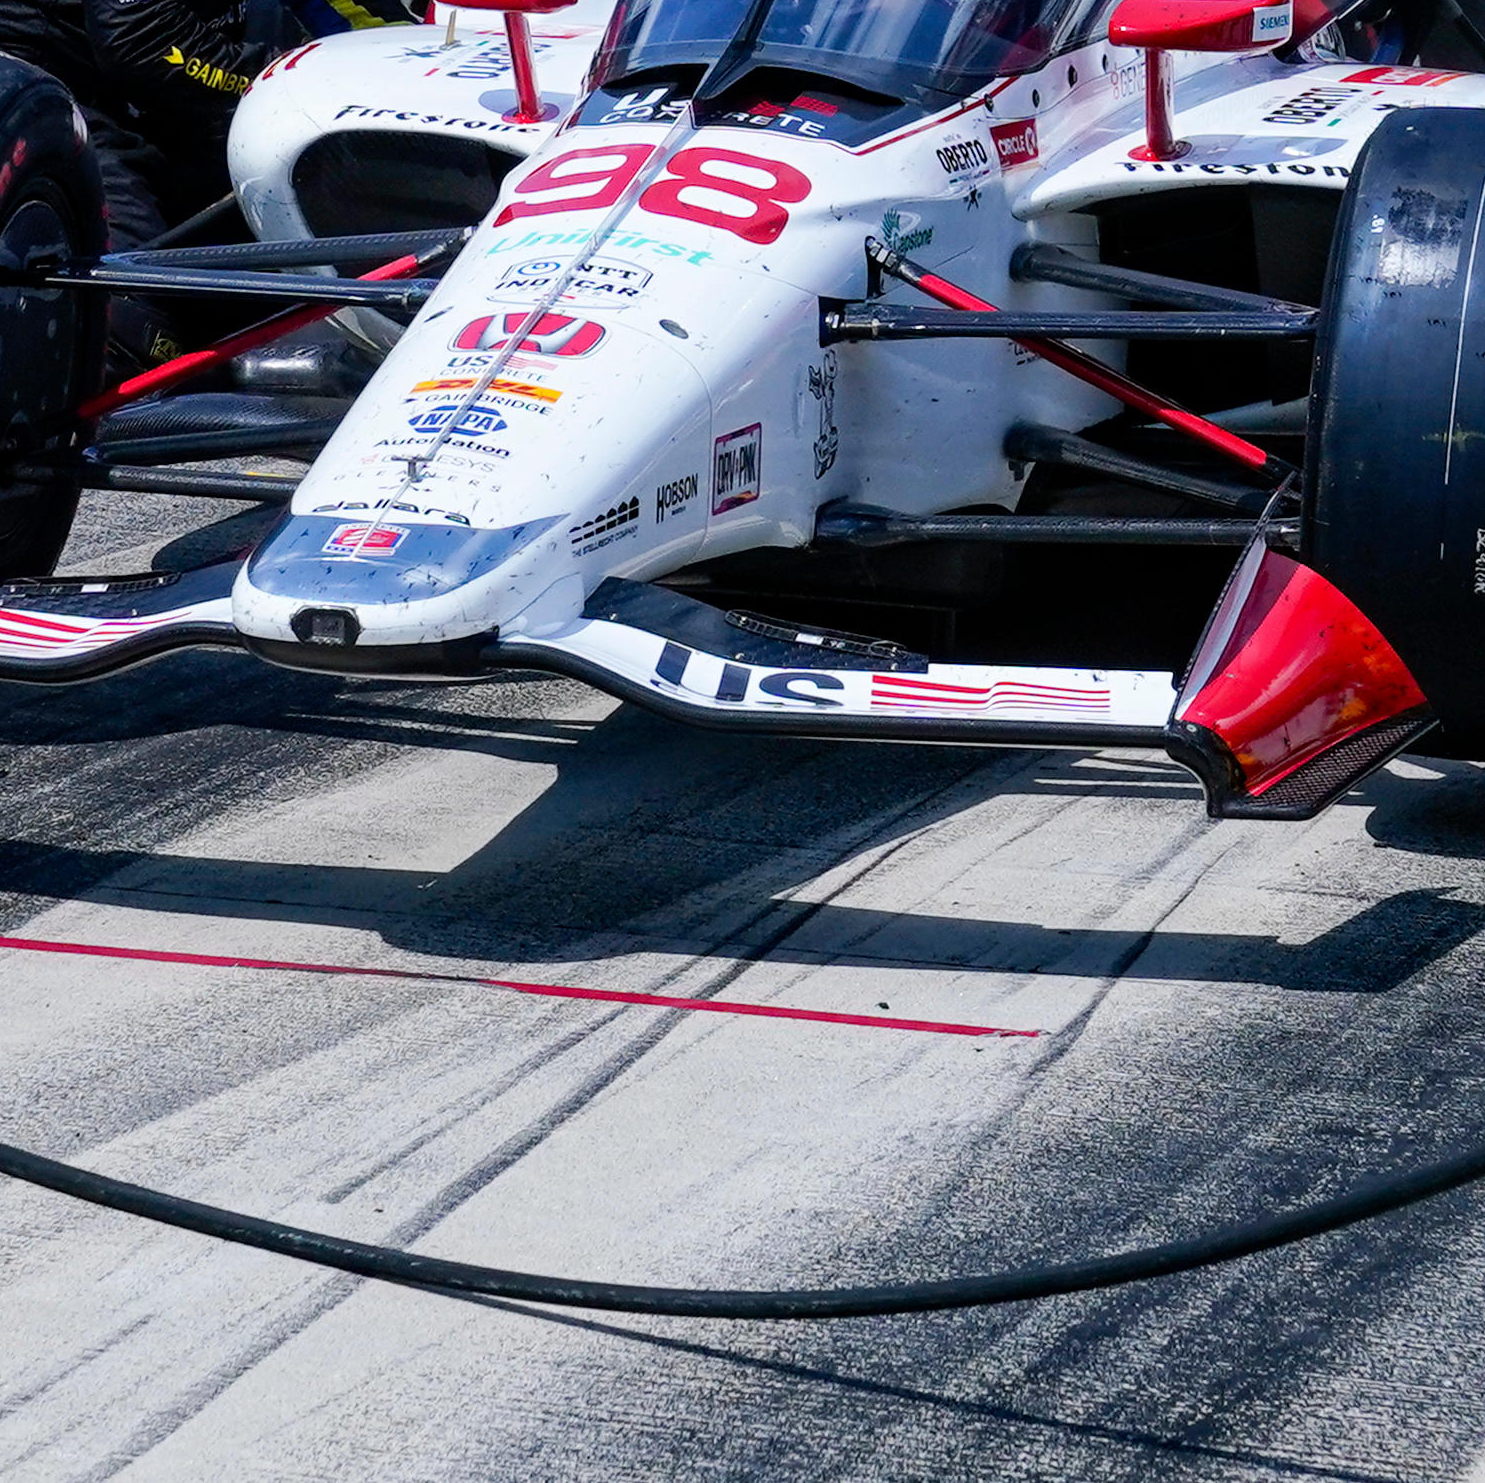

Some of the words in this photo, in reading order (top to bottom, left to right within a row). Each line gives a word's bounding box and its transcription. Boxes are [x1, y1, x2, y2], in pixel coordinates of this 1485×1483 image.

[1259, 14, 1290, 31] SIEMEN
[185, 57, 253, 96] GAINBR
[332, 103, 541, 134] Firestone
[599, 106, 827, 137] CONRETE
[935, 139, 989, 175] OBERTO
[998, 135, 1026, 157] CIRCLE
[1114, 160, 1351, 179] Fireston
[493, 143, 813, 246] 98
[576, 263, 638, 279] NTT
[494, 275, 640, 297] INDCAR
[447, 355, 493, 368] US
[440, 367, 549, 383] CONRETE
[381, 453, 496, 473] GESYS
[656, 473, 699, 525] HOBSON
[313, 498, 471, 526] dallara
[650, 640, 844, 709] US
